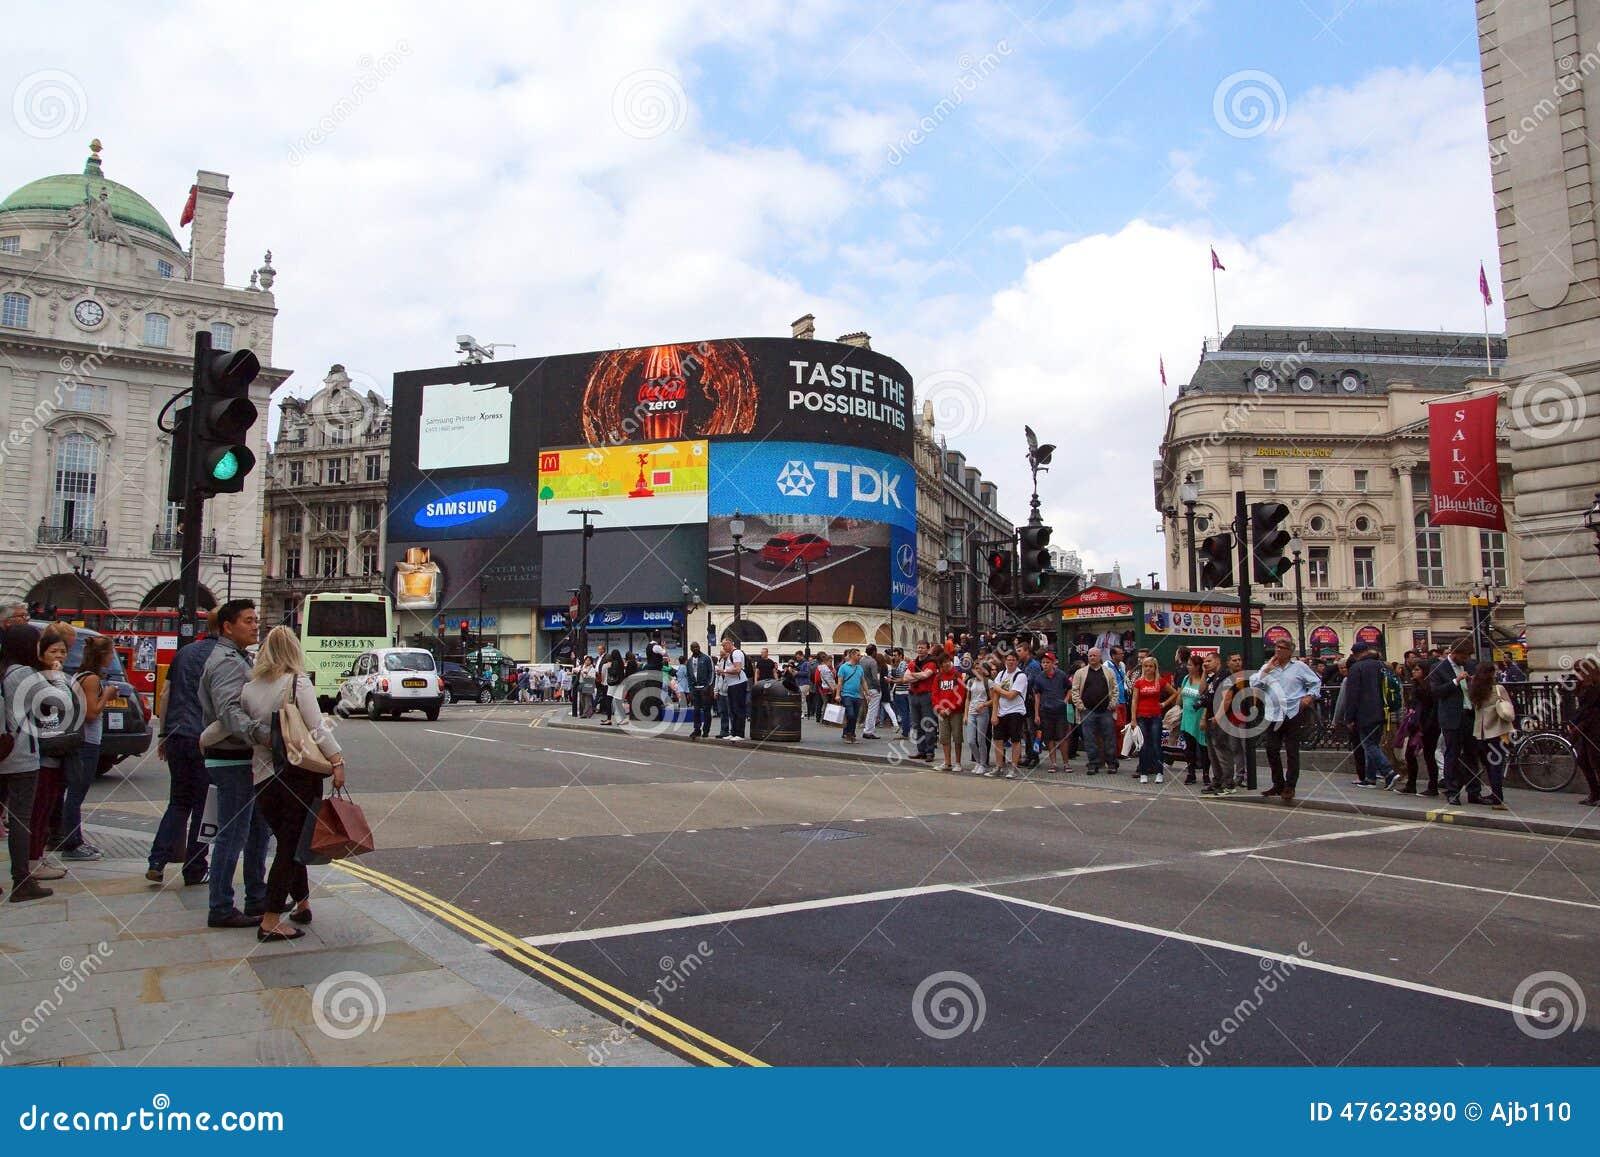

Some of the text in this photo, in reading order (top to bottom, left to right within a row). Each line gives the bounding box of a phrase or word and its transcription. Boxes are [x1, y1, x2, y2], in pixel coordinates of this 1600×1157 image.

[789, 360, 905, 408] TASTE THE
[648, 400, 677, 411] zero
[788, 390, 905, 431] POSSIBILITIES
[425, 417, 454, 425] Samsung
[479, 411, 504, 421] Xpress
[1451, 409, 1468, 485] SALE
[813, 461, 902, 509] TDK
[426, 499, 497, 517] SAMSUNG
[643, 609, 674, 621] beauty
[1078, 607, 1092, 615] BUS
[1093, 605, 1115, 614] TOURS
[320, 639, 376, 649] ROSELYN
